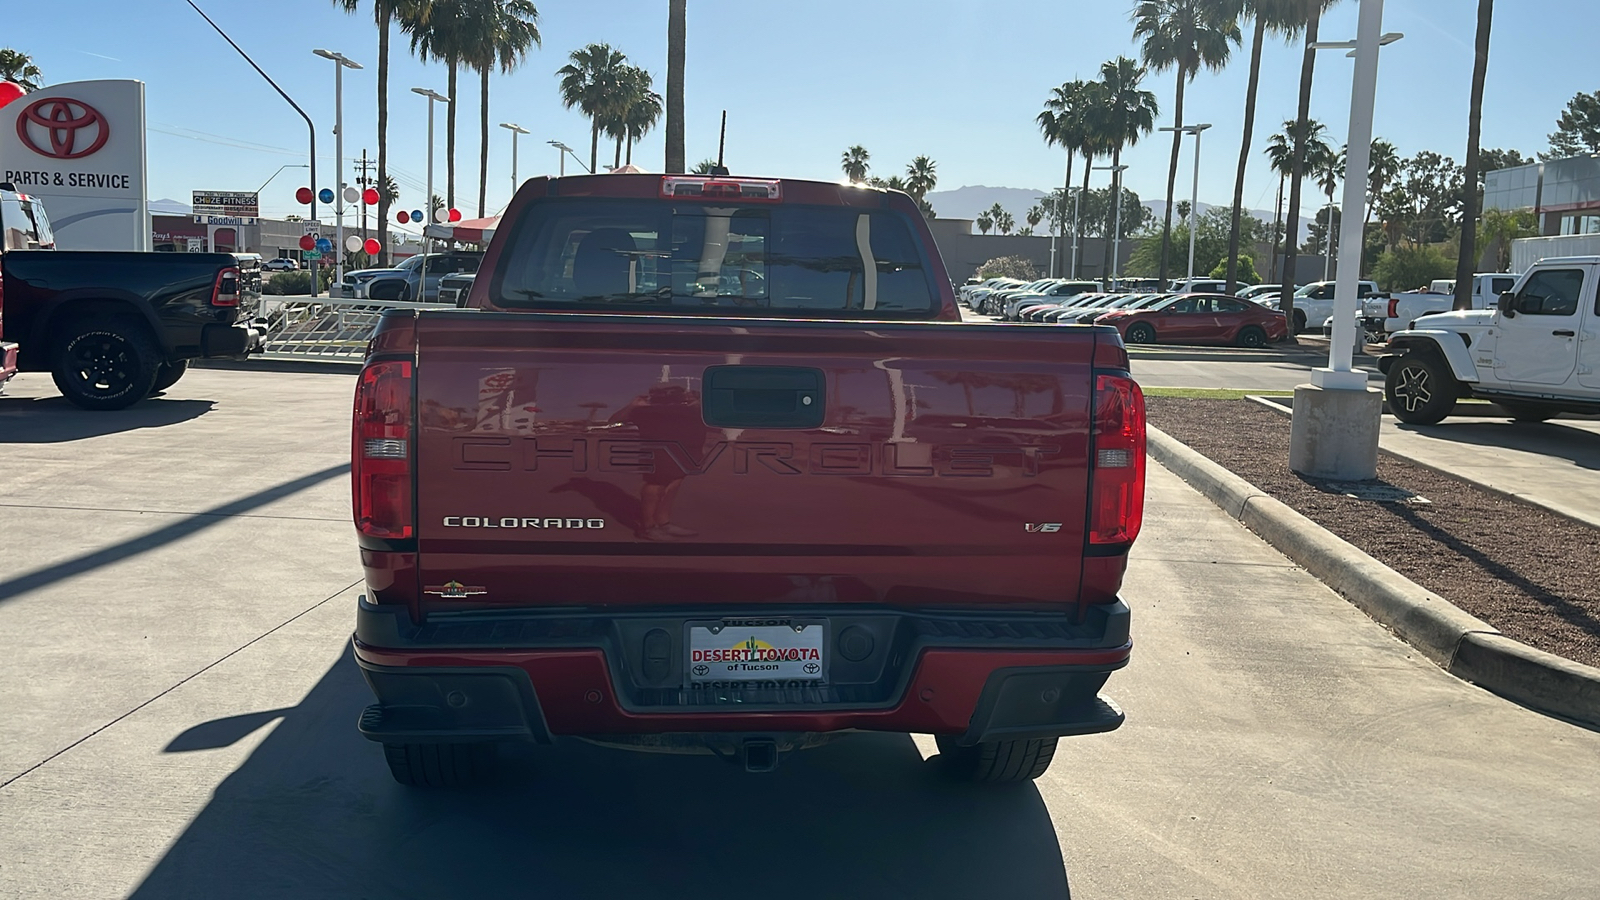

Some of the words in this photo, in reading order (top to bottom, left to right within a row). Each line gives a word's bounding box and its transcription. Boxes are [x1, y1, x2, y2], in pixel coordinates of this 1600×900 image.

[5, 170, 49, 185] PARTS
[53, 172, 64, 186] &
[69, 172, 130, 189] SERVICE
[223, 197, 256, 205] FITNESS
[208, 215, 243, 225] Goodwil
[452, 436, 1061, 477] CHEVROLET
[443, 516, 605, 529] COLORADO
[1024, 523, 1063, 533] V6
[722, 619, 791, 627] TUCSON
[692, 649, 751, 662] DESERT
[757, 648, 820, 661] TOYOTA
[740, 663, 779, 671] Tucson
